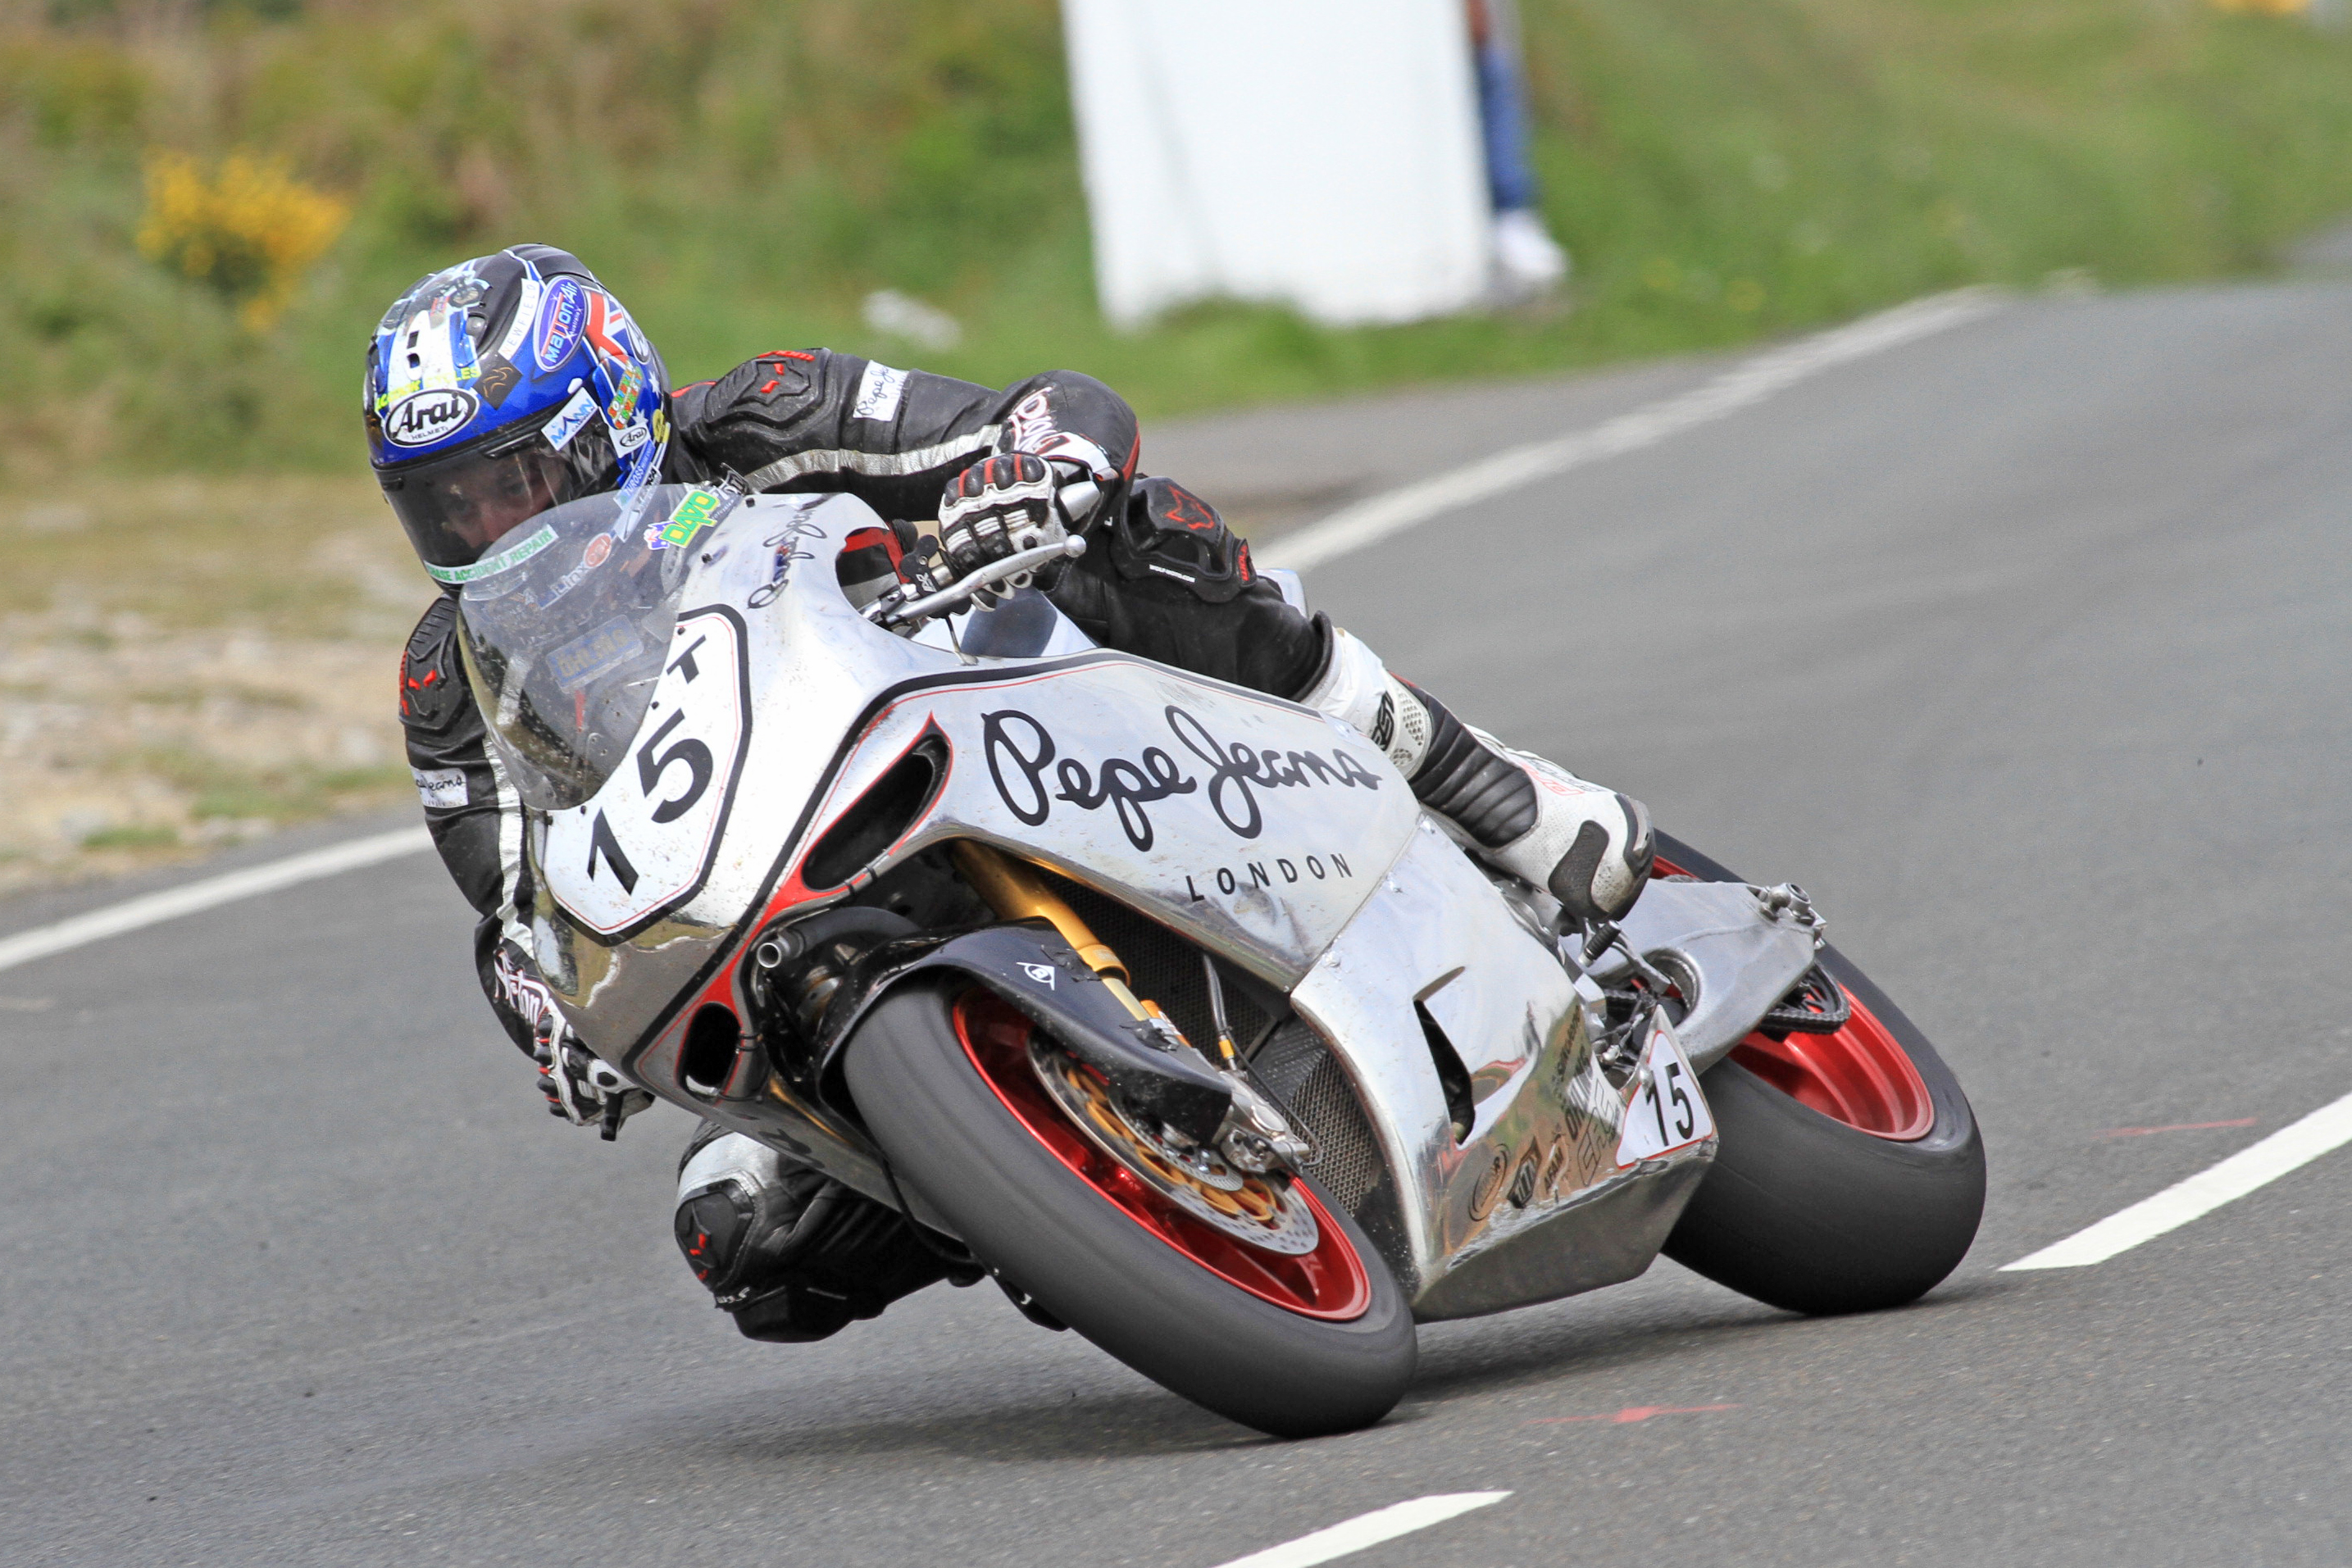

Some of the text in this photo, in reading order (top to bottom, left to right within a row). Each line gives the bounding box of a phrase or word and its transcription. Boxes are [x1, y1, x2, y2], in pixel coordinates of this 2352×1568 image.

[390, 393, 464, 439] Arai
[981, 705, 1382, 852] Pepe Jeans
[1187, 853, 1352, 902] LONDON
[1645, 1062, 1694, 1147] 15
